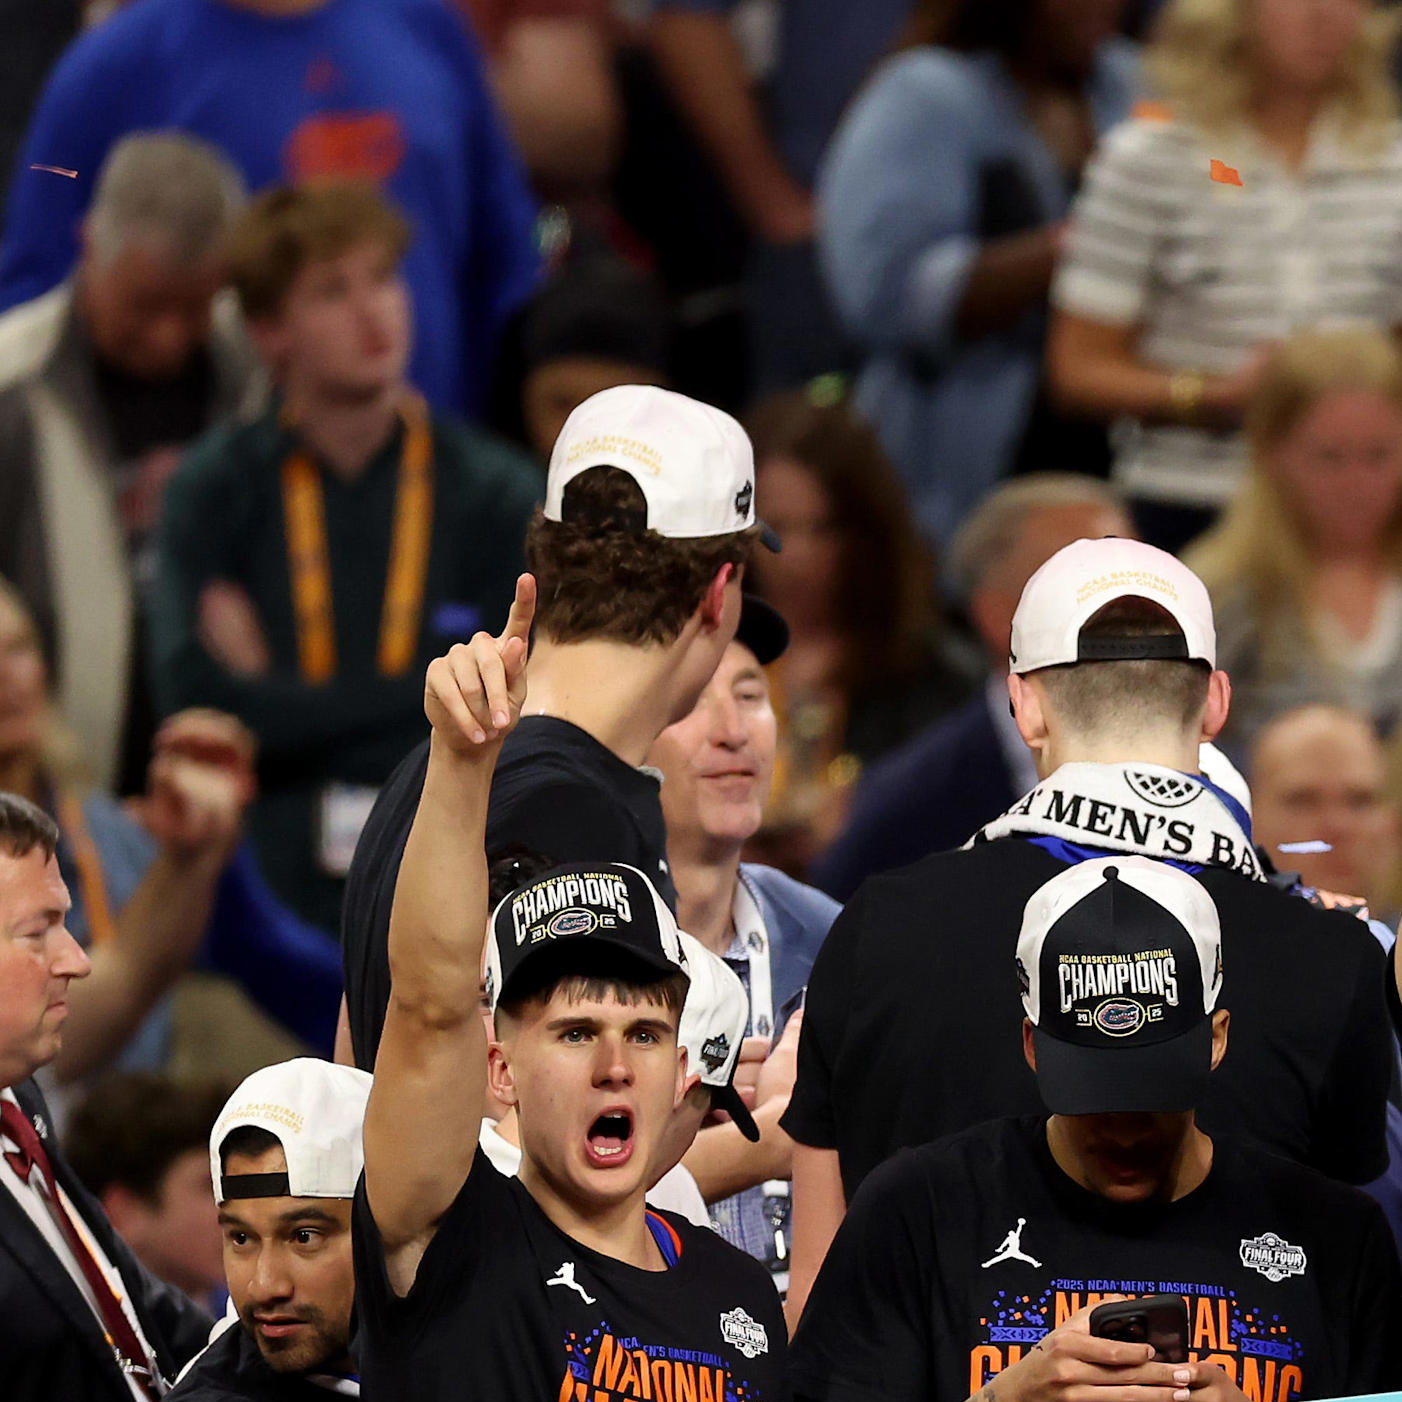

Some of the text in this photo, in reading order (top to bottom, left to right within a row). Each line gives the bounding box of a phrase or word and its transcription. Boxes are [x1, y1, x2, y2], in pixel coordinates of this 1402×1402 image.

[1043, 790, 1195, 855] MEN'S
[532, 873, 580, 893] BASKETBALL
[583, 873, 623, 882] NATIONAL
[512, 878, 632, 946] CHAMPIONS
[1059, 948, 1174, 964] NCAA BASKETBALL NATIONAL
[1058, 957, 1179, 1014] CHAMPIONS
[1151, 1008, 1162, 1017] 25
[1245, 1247, 1302, 1266] FINAL FOUR
[1056, 1279, 1084, 1290] 2025
[1121, 1281, 1155, 1292] MEN'S
[1159, 1282, 1226, 1297] BASKETBALL
